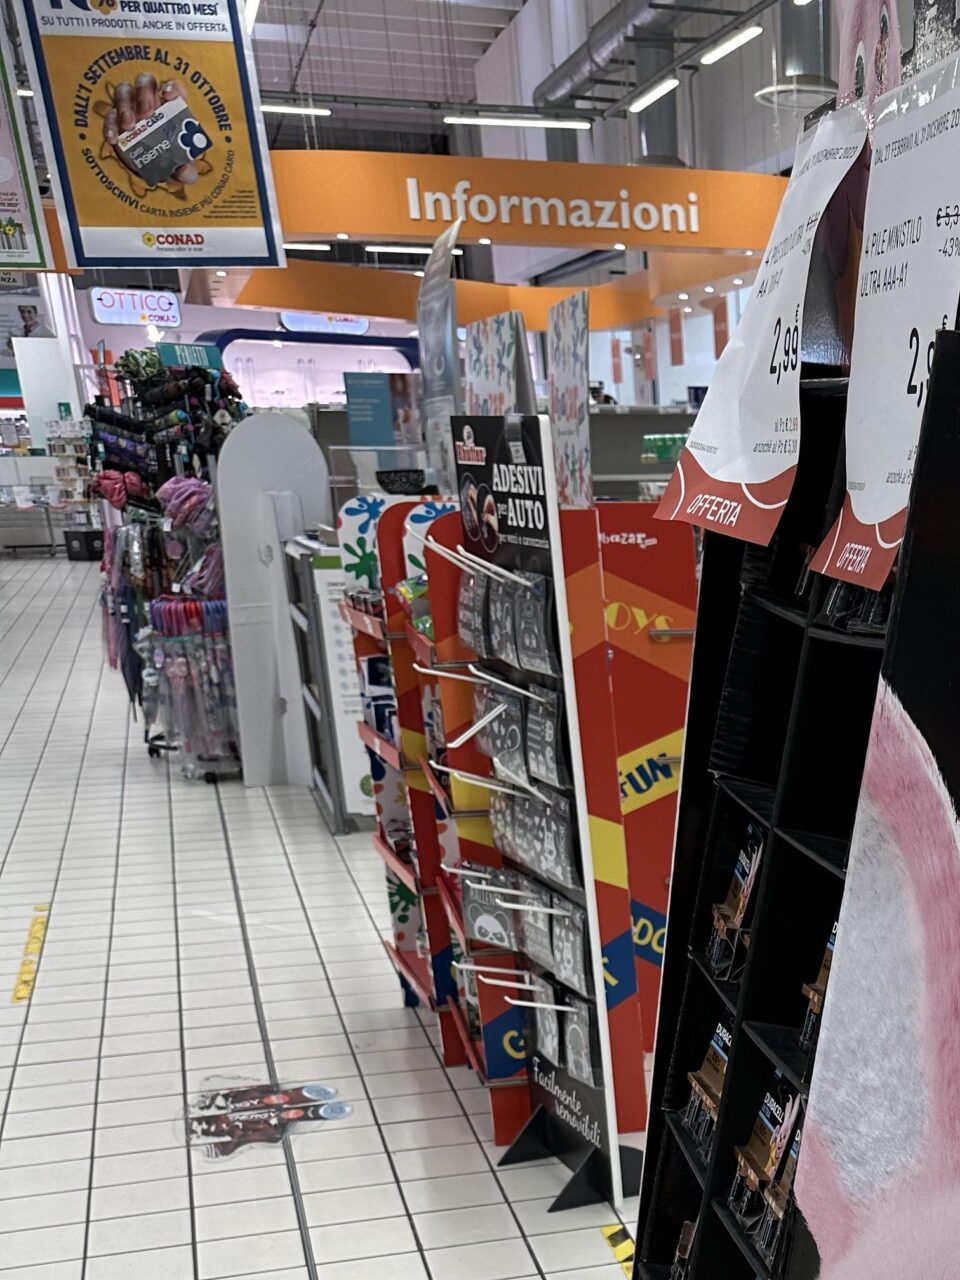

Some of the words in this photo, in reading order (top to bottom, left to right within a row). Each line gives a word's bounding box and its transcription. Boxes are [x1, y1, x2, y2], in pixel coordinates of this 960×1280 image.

[120, 1, 141, 13] PER
[143, 2, 191, 15] QUATTRO
[41, 15, 55, 26] SU
[58, 16, 84, 27] TUTTI
[142, 20, 174, 30] ANCHE
[176, 22, 186, 31] IN
[187, 23, 228, 33] OFFERTA
[83, 45, 152, 85] SETTEMBRE
[153, 48, 171, 66] AL
[173, 57, 191, 75] 31
[190, 71, 232, 132] OTTOBRE
[891, 133, 914, 158] FEBBRAIO
[927, 111, 951, 140] DICEMBRE
[82, 148, 140, 210] SOTTOSCRIVI
[139, 204, 169, 218] CARTA
[169, 205, 202, 218] INSIEME
[406, 177, 699, 233] Informazioni
[156, 233, 205, 246] CONAD
[870, 229, 888, 258] PILE
[860, 269, 881, 298] ULTRA
[882, 261, 909, 292] AAA-A1
[100, 291, 172, 312] OTTICO
[148, 314, 178, 323] CONAD
[770, 317, 799, 385] 2,99
[492, 464, 545, 495] ADESIVI
[507, 500, 544, 530] AUTO
[687, 494, 742, 527] OFFERTA
[836, 542, 872, 574] OFFERTA
[532, 1056, 583, 1117] Facilmente
[764, 1092, 785, 1123] DURACELL
